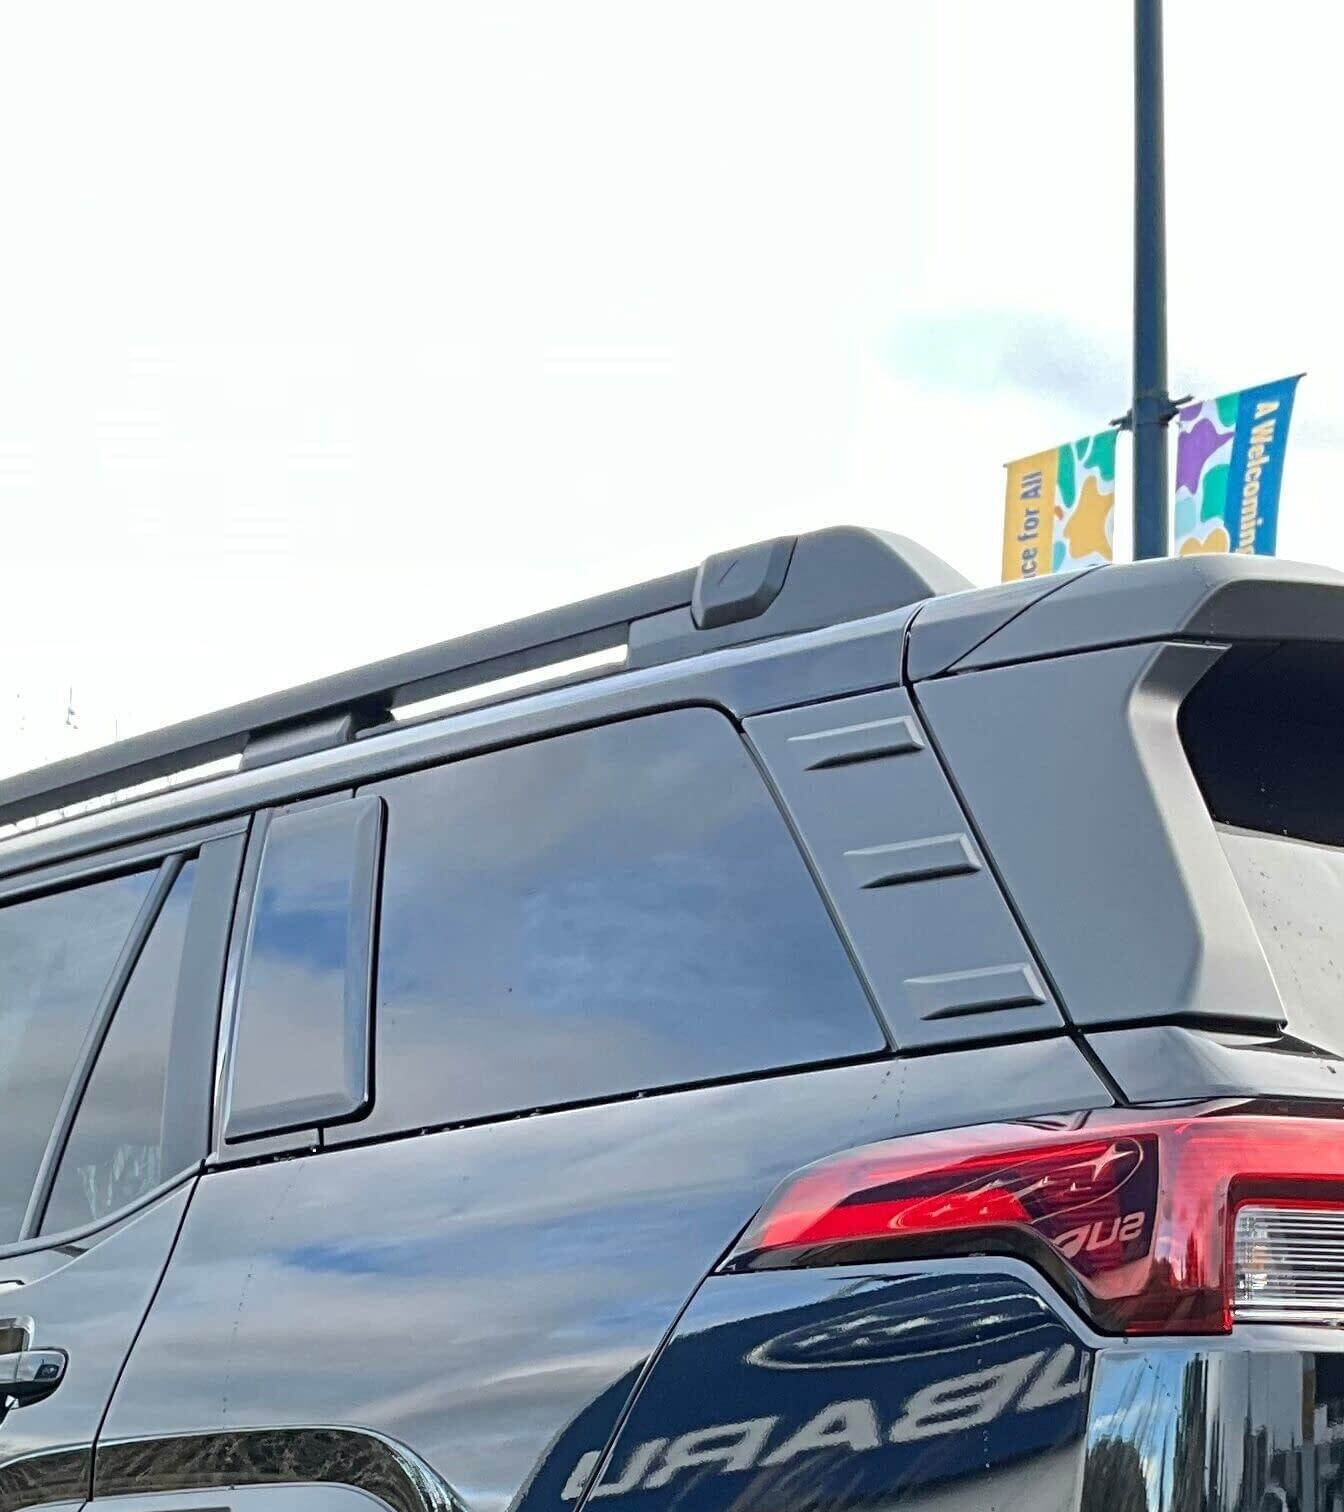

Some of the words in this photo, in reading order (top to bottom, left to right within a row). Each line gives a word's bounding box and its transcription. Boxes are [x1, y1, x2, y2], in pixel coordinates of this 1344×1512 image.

[1254, 400, 1280, 419] A
[1019, 470, 1042, 500] All
[1017, 508, 1040, 542] for
